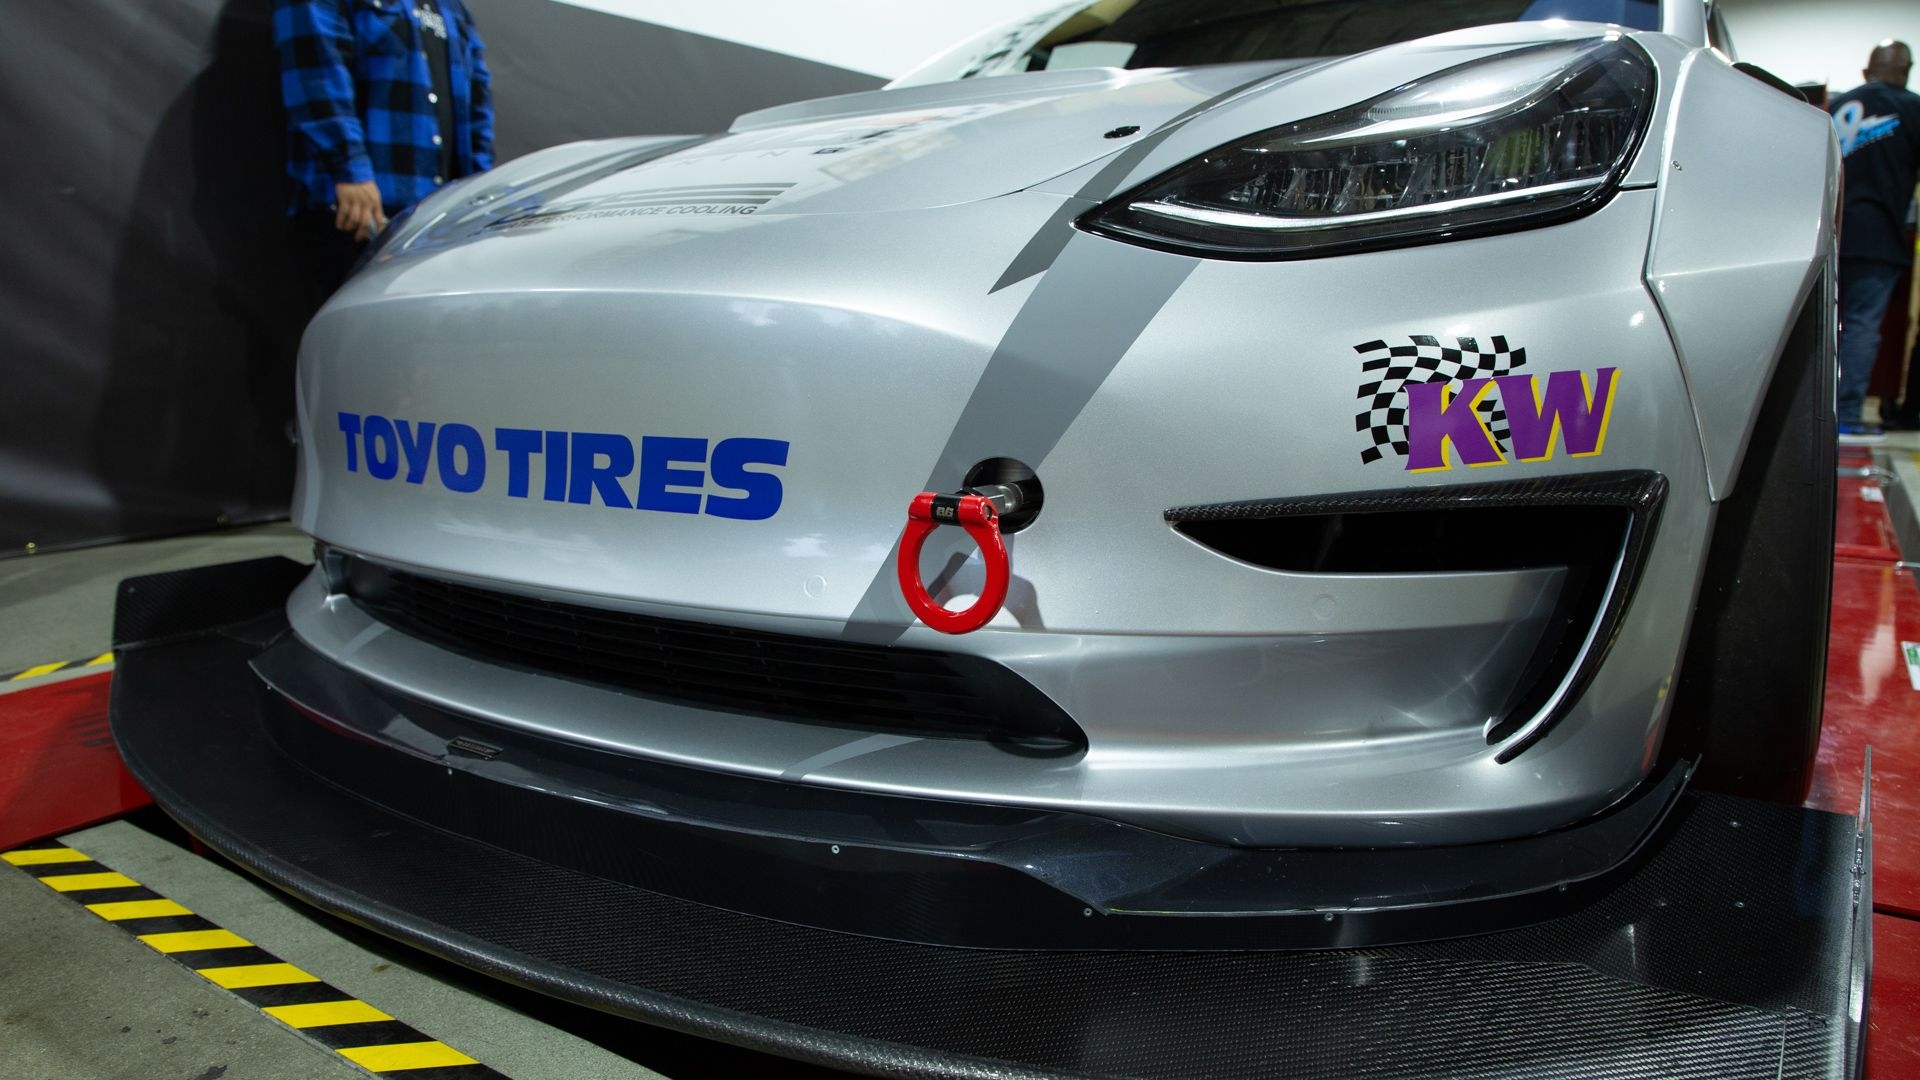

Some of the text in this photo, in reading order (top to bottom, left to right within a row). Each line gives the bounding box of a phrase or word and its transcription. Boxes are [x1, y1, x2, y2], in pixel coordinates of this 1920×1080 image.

[666, 205, 758, 215] COOLING
[337, 412, 790, 521] TOYO TIRES
[1402, 366, 1622, 474] KW
